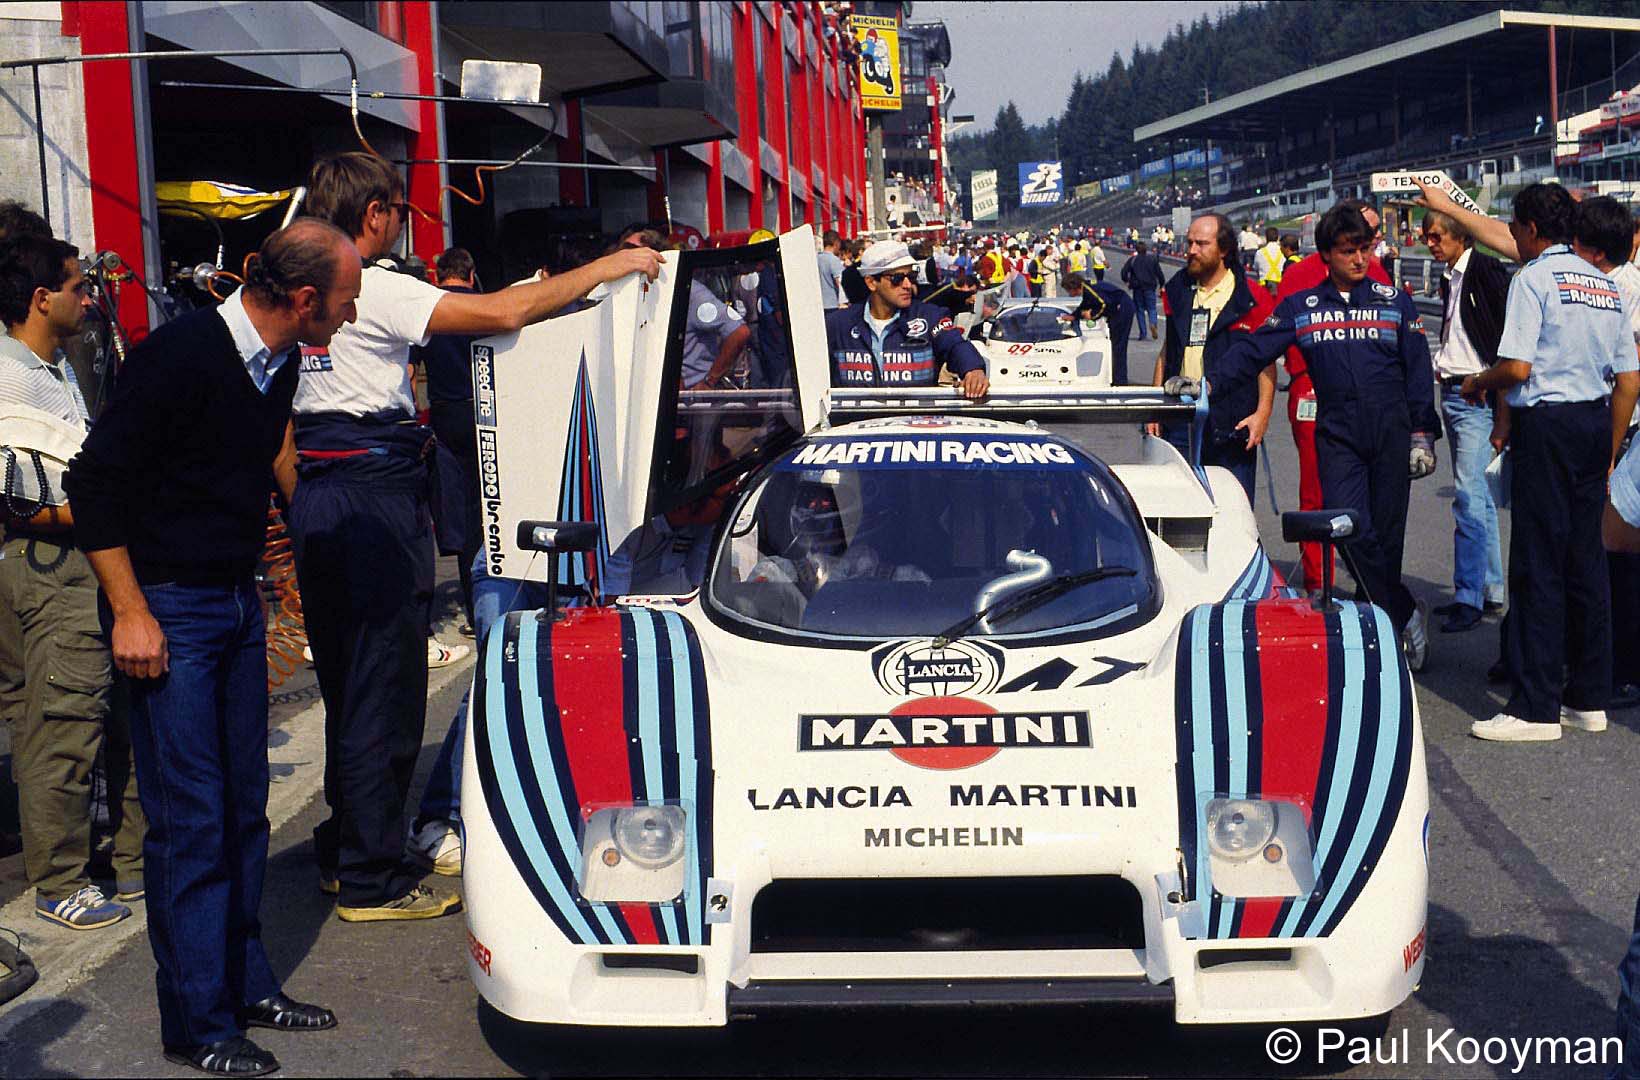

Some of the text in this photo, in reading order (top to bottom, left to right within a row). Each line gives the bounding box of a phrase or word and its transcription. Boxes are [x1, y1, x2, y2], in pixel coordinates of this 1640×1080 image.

[853, 16, 896, 27] MICHELIN
[1392, 175, 1441, 187] TEXCO
[1563, 272, 1611, 291] MARTINI
[1570, 289, 1615, 309] RACING
[1310, 309, 1378, 323] MARTINI
[1313, 328, 1379, 343] RACING
[845, 351, 912, 363] MARTINI
[476, 345, 494, 418] speedline
[847, 370, 912, 381] RACING
[1018, 370, 1048, 378] SPAX
[792, 440, 1075, 464] MARTINI RACING
[480, 431, 498, 498] FERODO
[486, 499, 505, 576] brembo
[908, 663, 974, 678] LANCIA
[811, 716, 1079, 746] MARTINI
[747, 784, 1137, 810] LANCIA MARTINI
[864, 826, 1024, 847] MICHELIN
